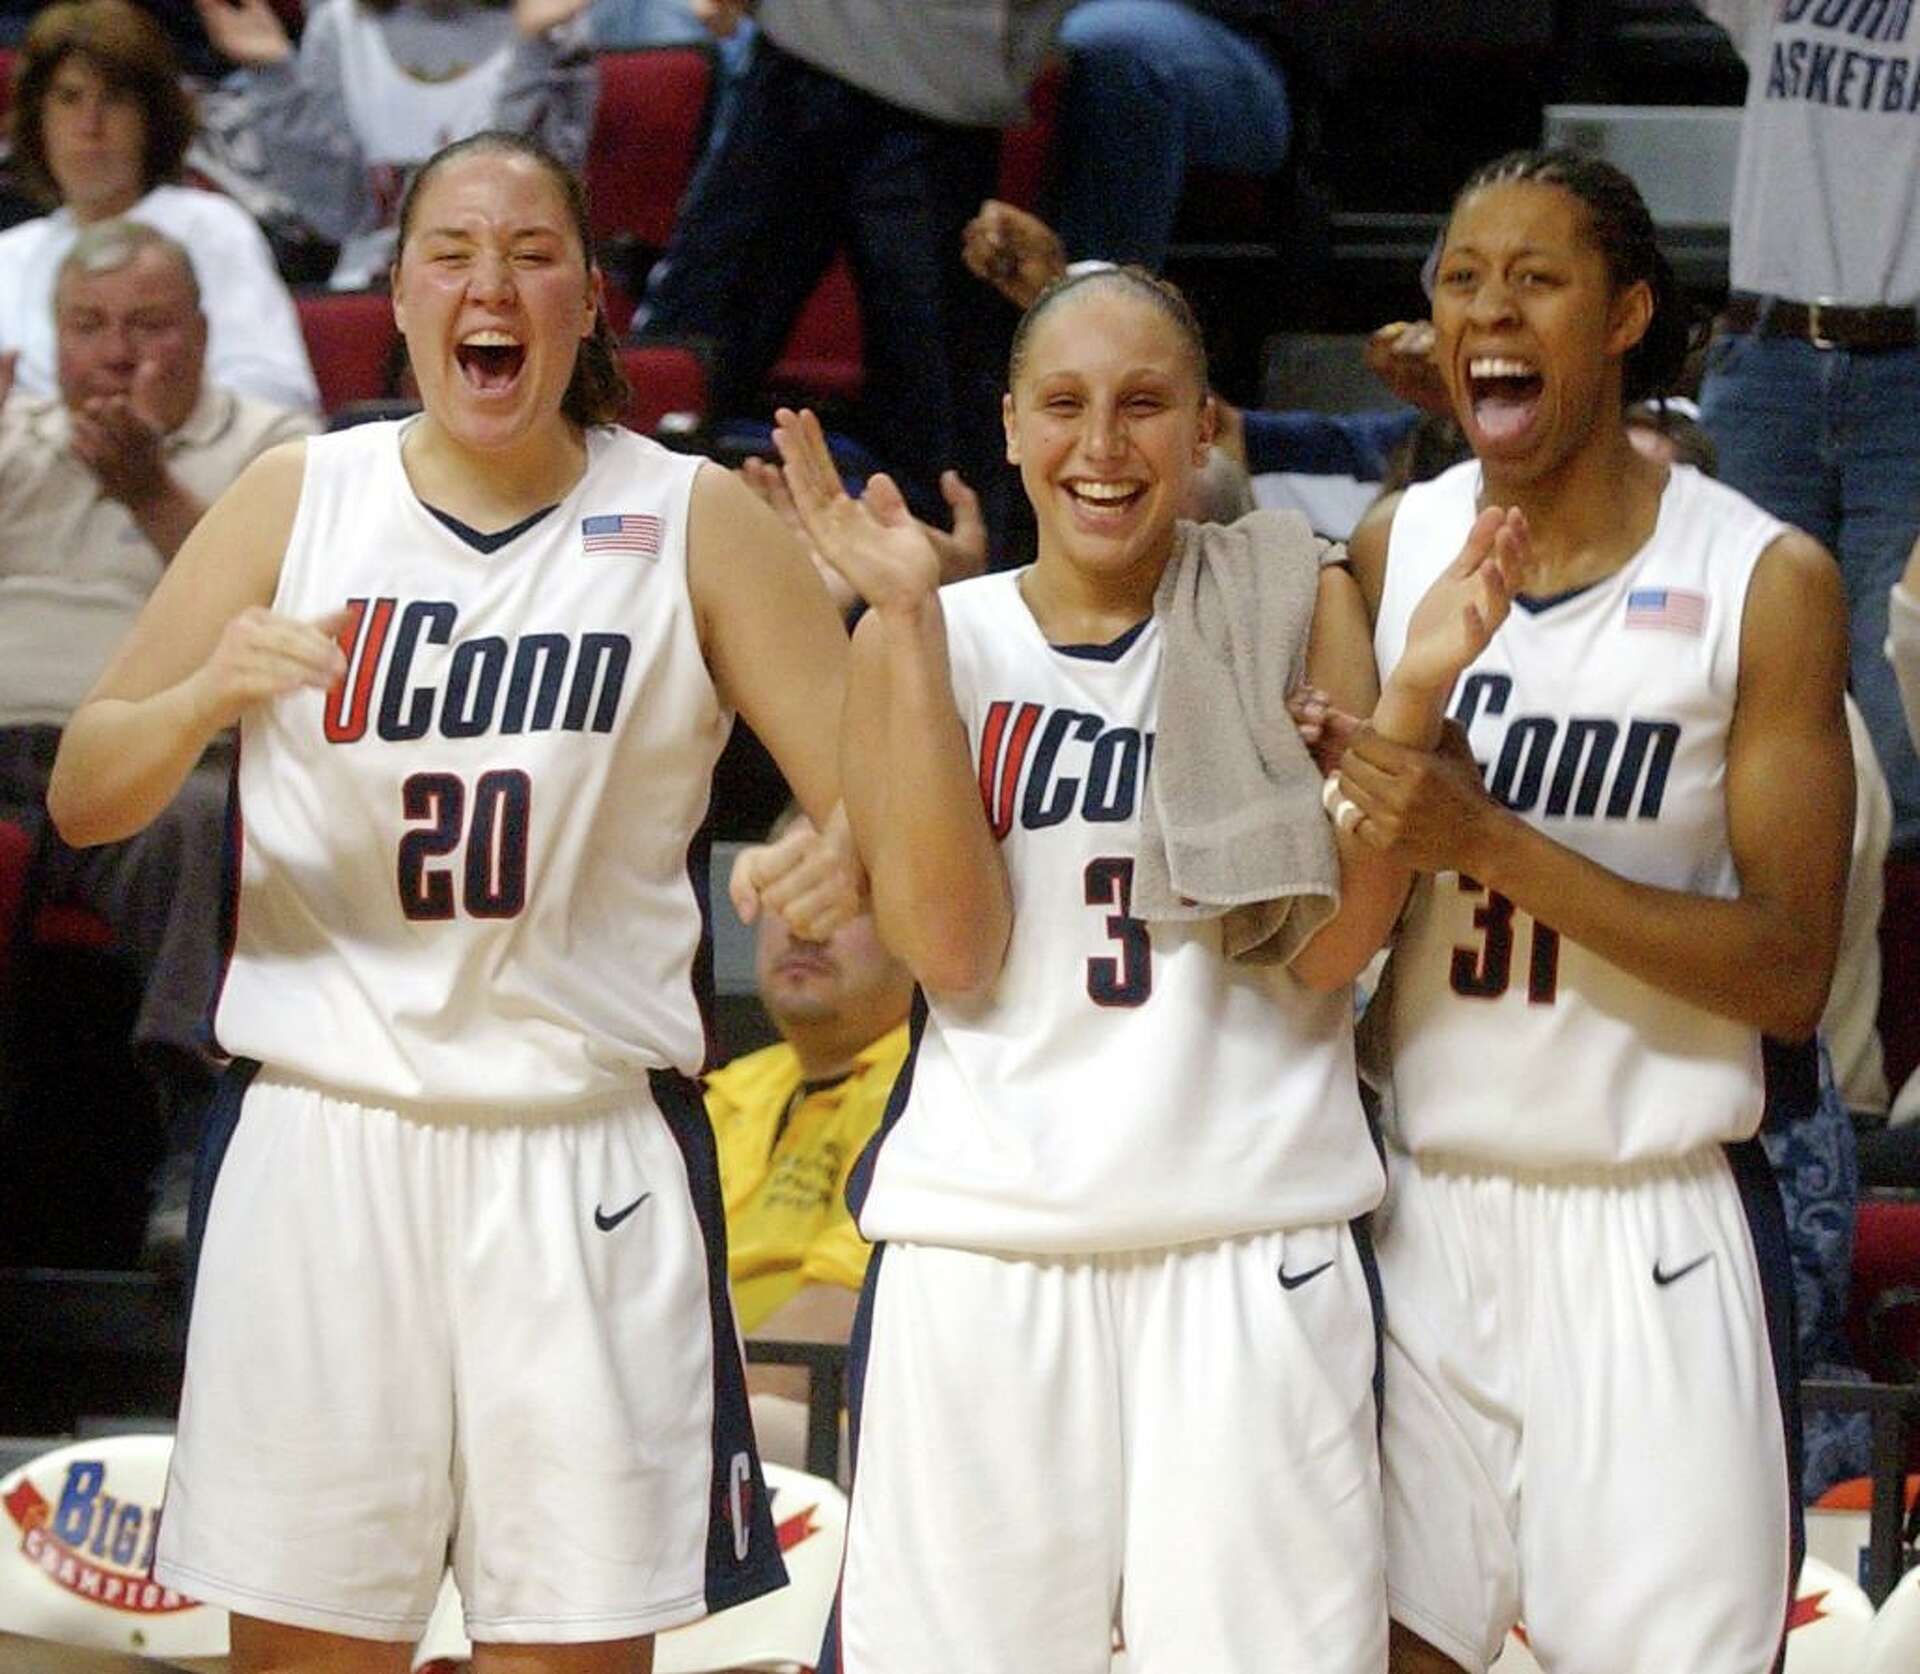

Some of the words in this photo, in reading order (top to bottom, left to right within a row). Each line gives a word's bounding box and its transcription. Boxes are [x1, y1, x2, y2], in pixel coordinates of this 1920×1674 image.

[323, 598, 632, 744] UConn
[979, 701, 1156, 841] UCo
[398, 769, 532, 921] 20
[1084, 857, 1152, 1008] 3
[1450, 873, 1561, 1005] 31
[25, 1528, 196, 1609] CHAMPION
